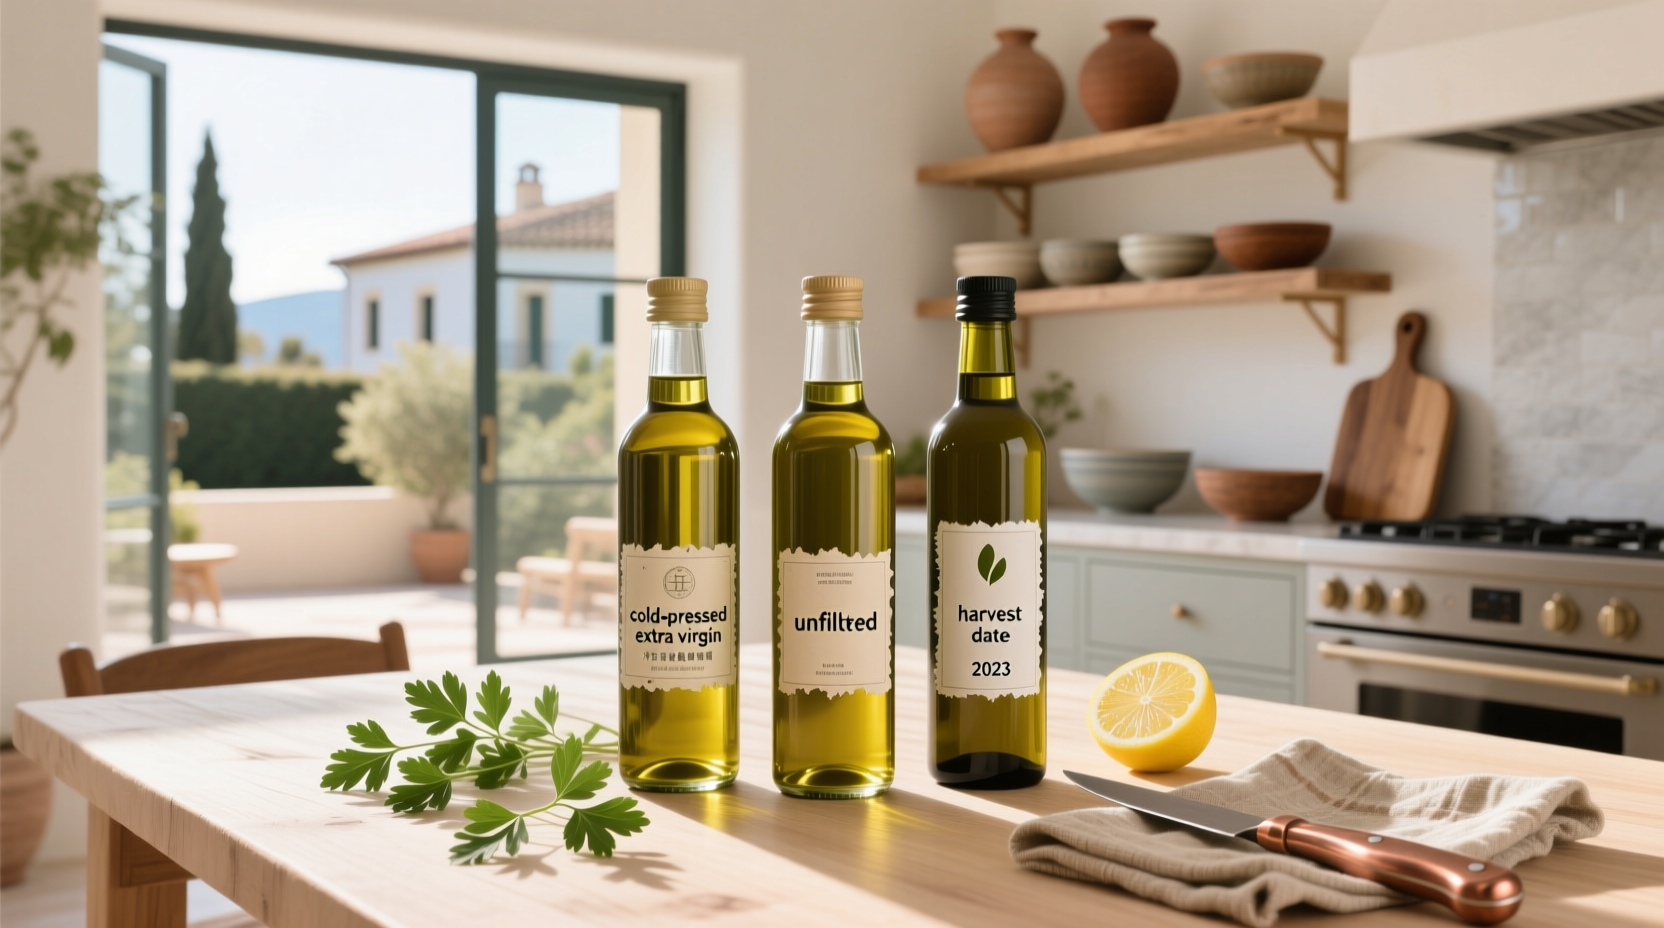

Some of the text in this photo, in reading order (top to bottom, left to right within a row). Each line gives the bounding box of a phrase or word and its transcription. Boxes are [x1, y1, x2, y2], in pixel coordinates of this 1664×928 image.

[630, 605, 727, 628] cold-pressed
[958, 604, 1023, 622] harvest
[635, 627, 722, 647] extra virgin
[971, 626, 1011, 643] date
[971, 661, 1011, 677] 2023
